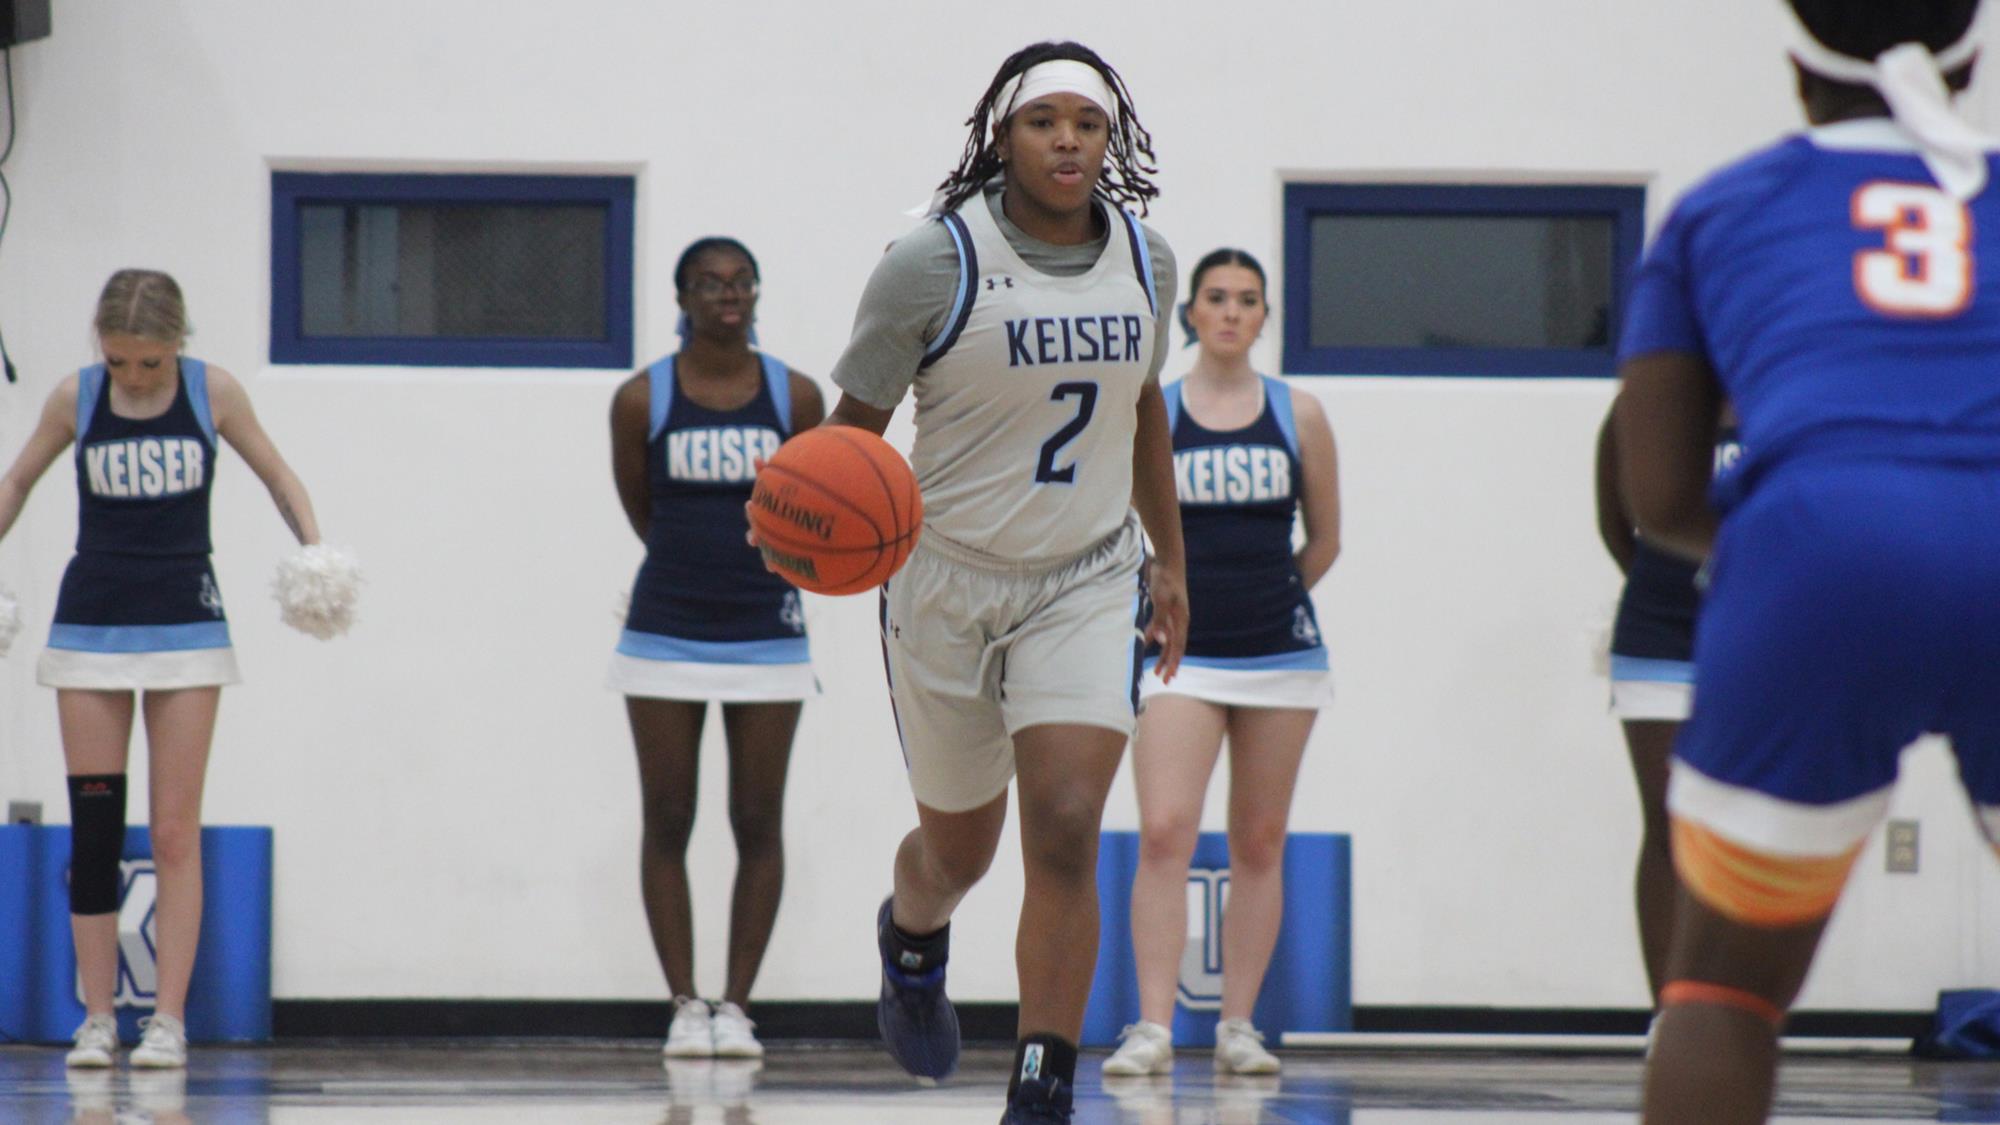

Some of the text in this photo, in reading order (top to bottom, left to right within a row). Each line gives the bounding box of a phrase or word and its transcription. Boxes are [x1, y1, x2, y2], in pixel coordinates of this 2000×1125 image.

[1851, 180, 1974, 318] 3
[1004, 315, 1142, 367] KEISER
[1034, 381, 1099, 484] 2
[85, 438, 204, 497] KEISER
[1174, 447, 1290, 502] KEISER
